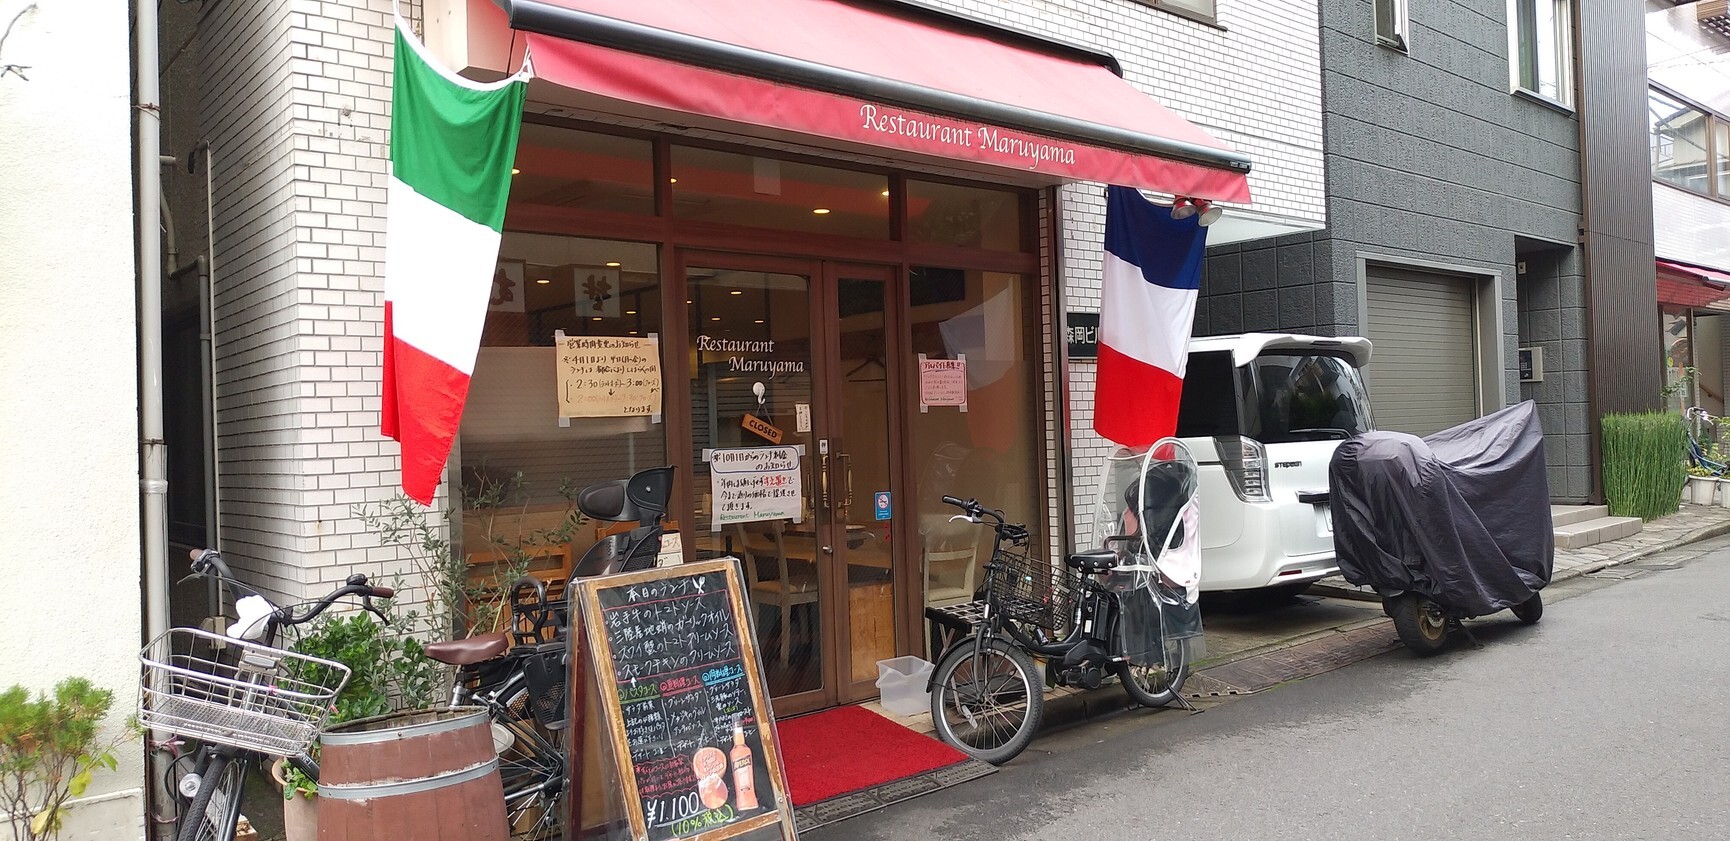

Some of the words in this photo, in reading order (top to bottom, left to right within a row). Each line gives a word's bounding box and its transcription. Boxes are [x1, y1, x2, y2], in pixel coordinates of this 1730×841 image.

[860, 104, 972, 147] Restaurant
[977, 127, 1076, 169] Maruyama
[696, 335, 775, 353] Restaurant
[728, 356, 804, 380] Maruyama
[749, 419, 777, 439] CLOSED
[626, 579, 690, 602] 本日のランチ
[609, 597, 707, 629] 岩手牛のトマトソース
[622, 640, 736, 680] スモークチキンのクリームソース
[671, 803, 735, 838] (10%税込)
